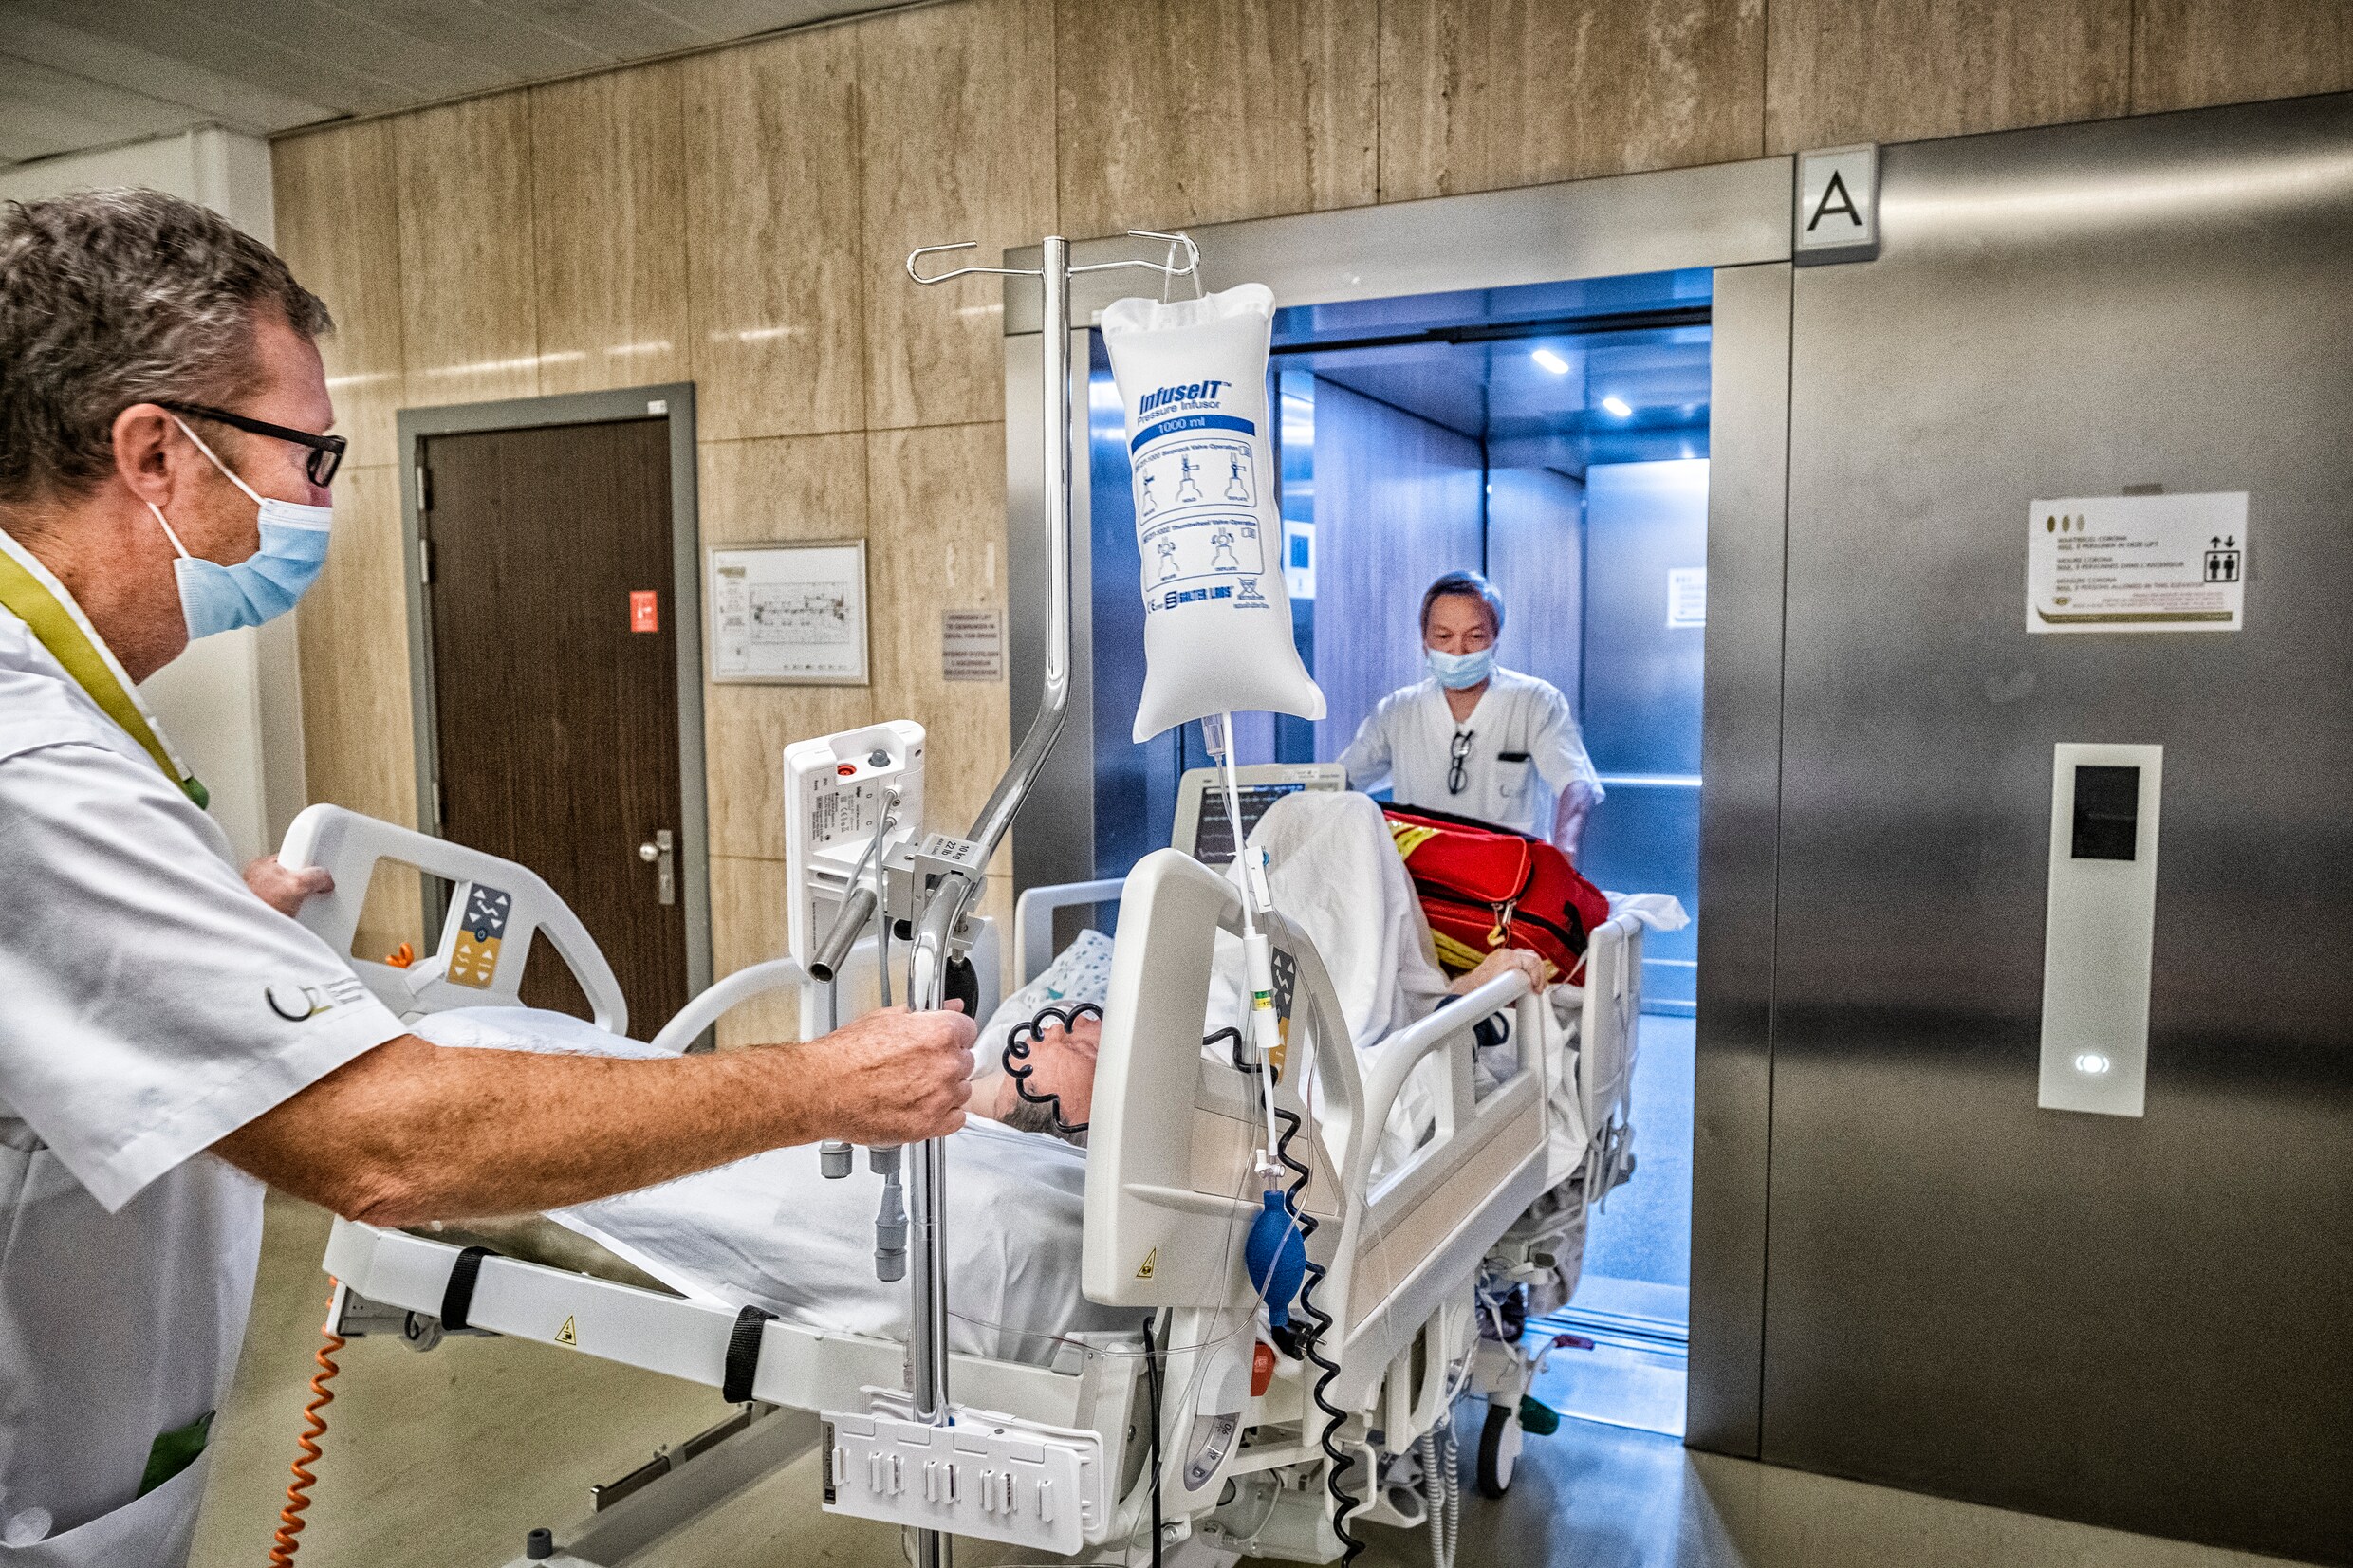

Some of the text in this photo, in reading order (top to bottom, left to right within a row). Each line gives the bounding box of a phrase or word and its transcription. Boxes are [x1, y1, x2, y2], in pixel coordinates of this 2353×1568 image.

[1806, 170, 1862, 231] A
[1137, 400, 1221, 427] Pressure Infusor
[1158, 416, 1206, 434] 1000 ml
[945, 840, 957, 850] 22
[952, 852, 966, 860] kg
